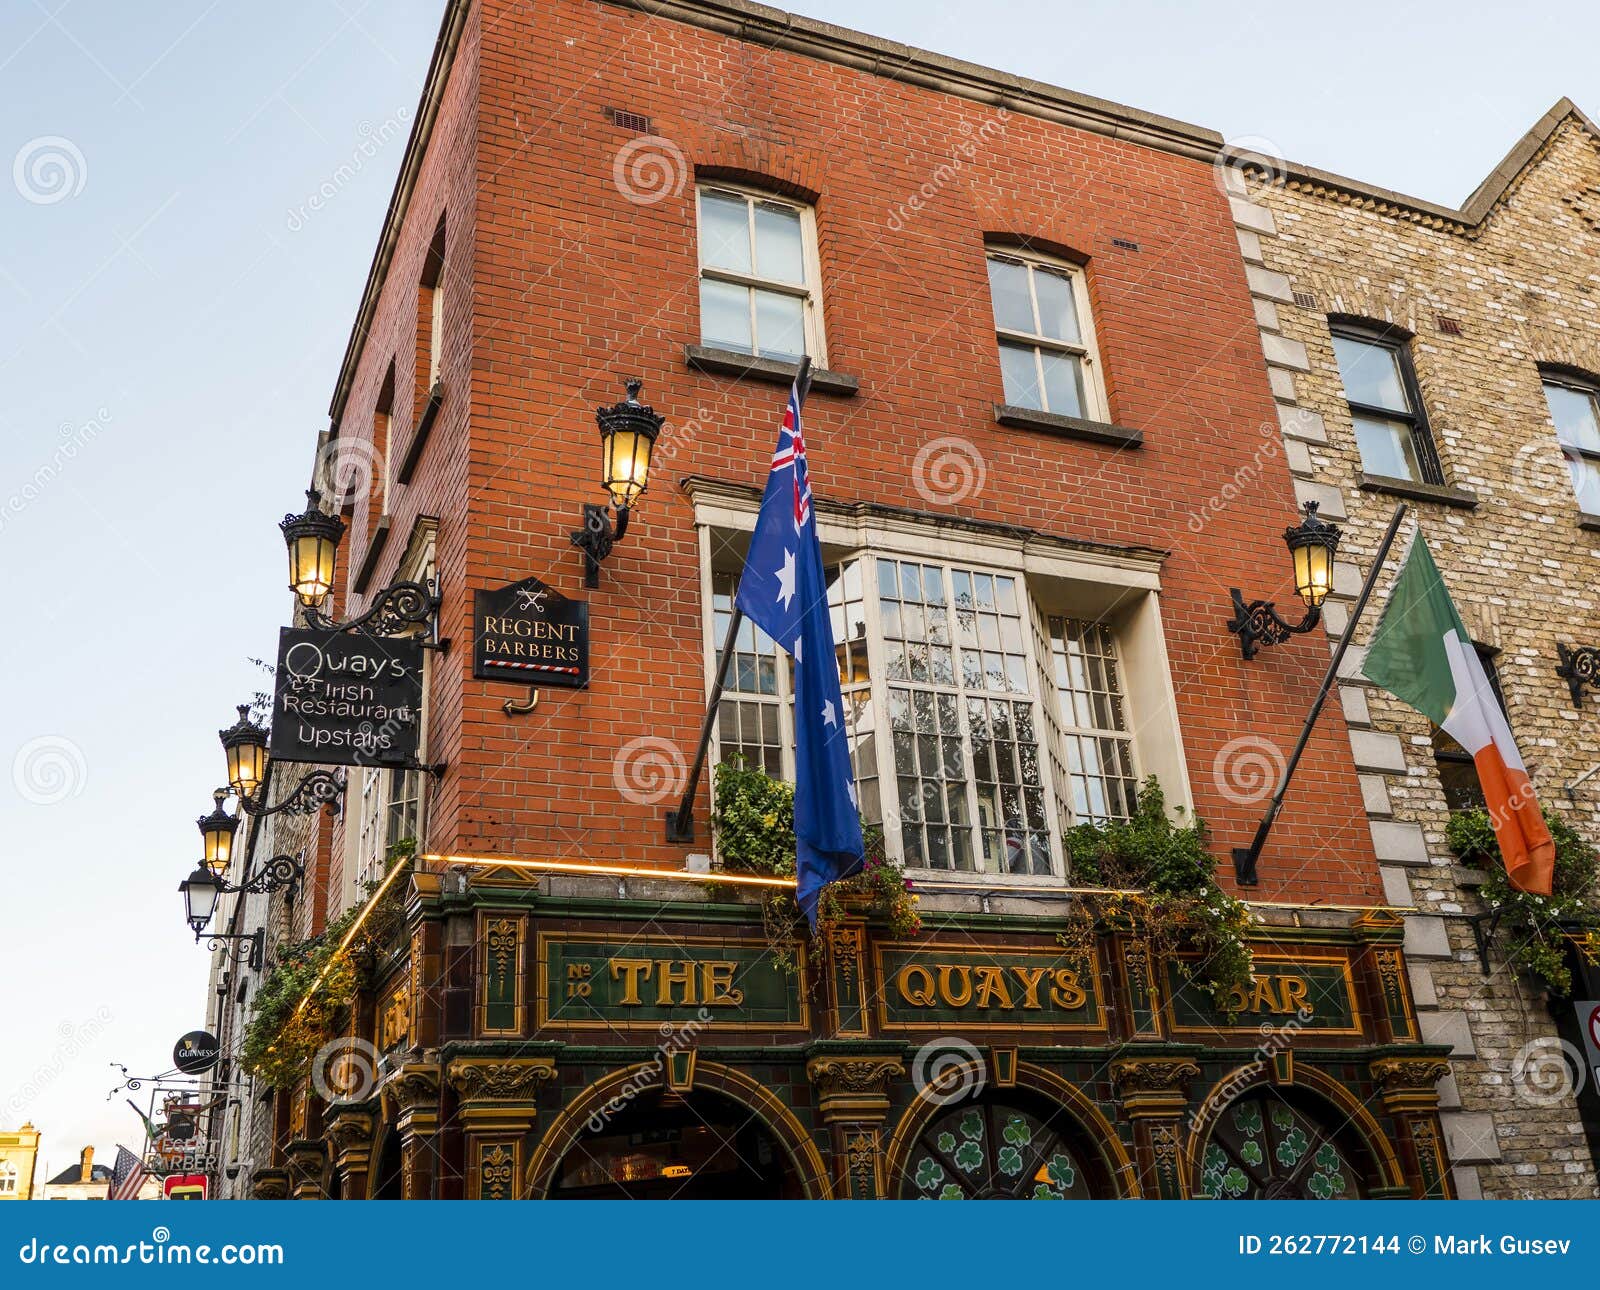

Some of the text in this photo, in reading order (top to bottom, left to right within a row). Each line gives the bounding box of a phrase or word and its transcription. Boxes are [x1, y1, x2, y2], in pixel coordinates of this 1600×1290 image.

[484, 615, 580, 642] REGENT
[286, 642, 405, 679] Quays
[485, 638, 579, 662] BARBERS
[325, 683, 374, 701] Irish
[283, 693, 411, 722] Restaurant
[299, 725, 391, 748] Upstairs
[567, 982, 592, 998] 10
[609, 958, 744, 1005] THE
[897, 964, 1087, 1009] QUAY'S
[178, 1049, 215, 1058] GUINNESS
